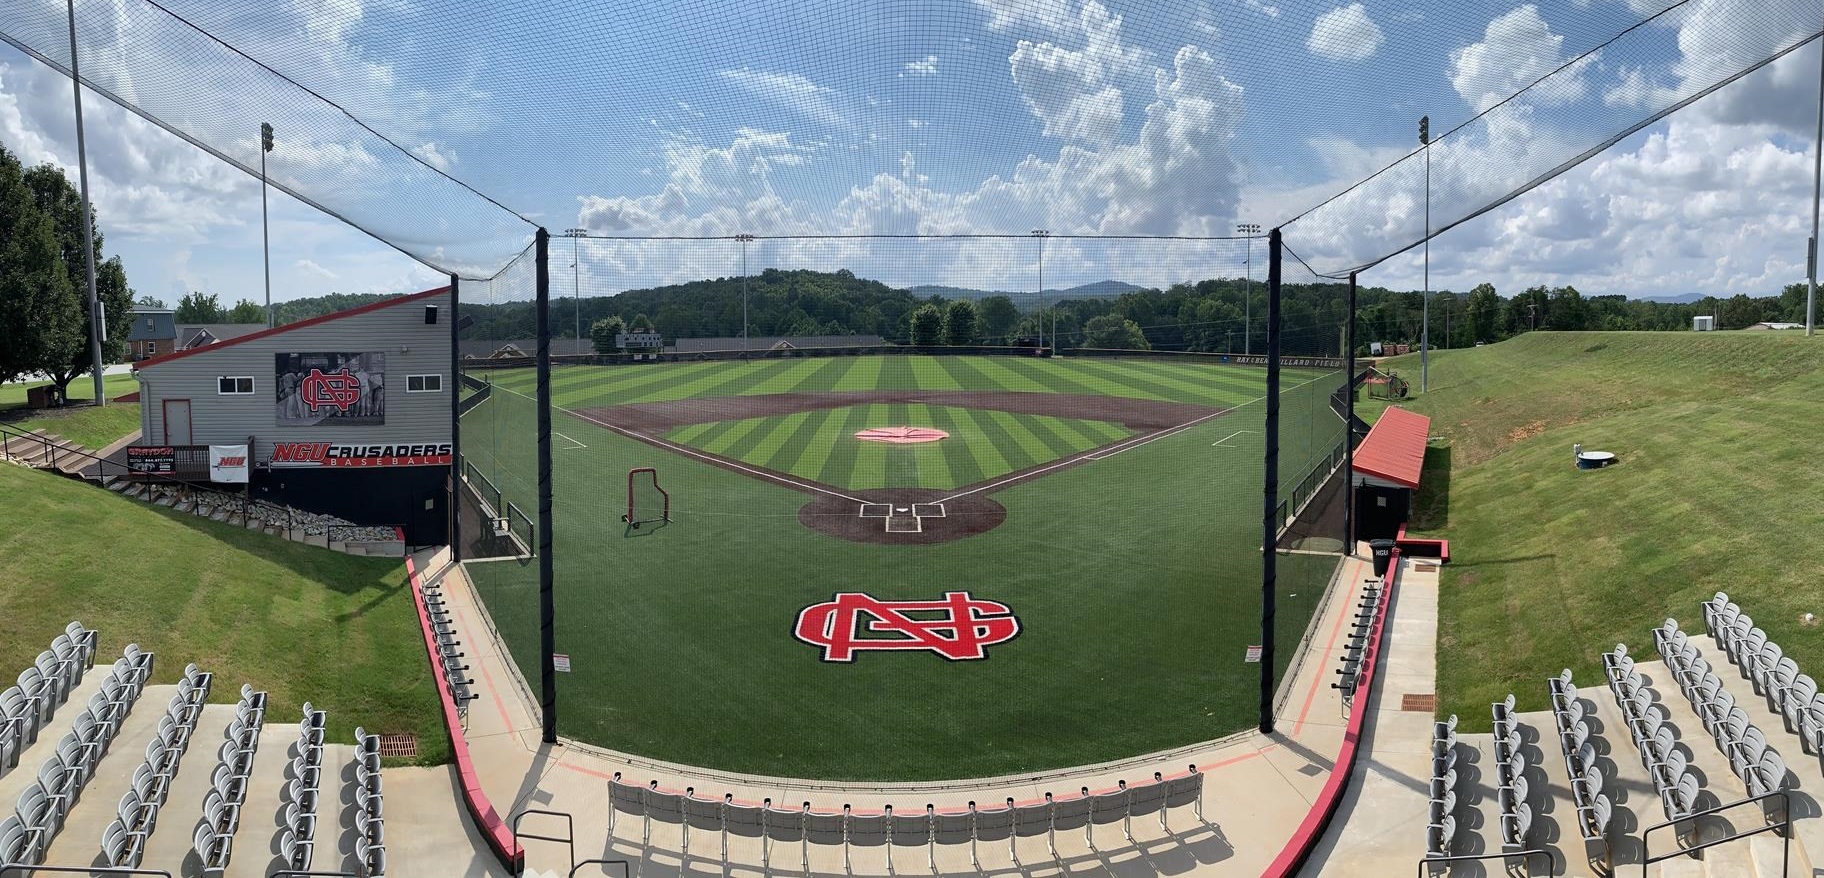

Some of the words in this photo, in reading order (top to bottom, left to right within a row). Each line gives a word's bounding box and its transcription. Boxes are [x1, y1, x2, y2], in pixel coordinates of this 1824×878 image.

[1236, 356, 1250, 364] RAY
[1279, 358, 1310, 366] ILLARD
[272, 442, 332, 463] NGU
[325, 444, 452, 458] CRUSADERS
[219, 456, 246, 467] NGU
[330, 456, 444, 467] BASEBALL
